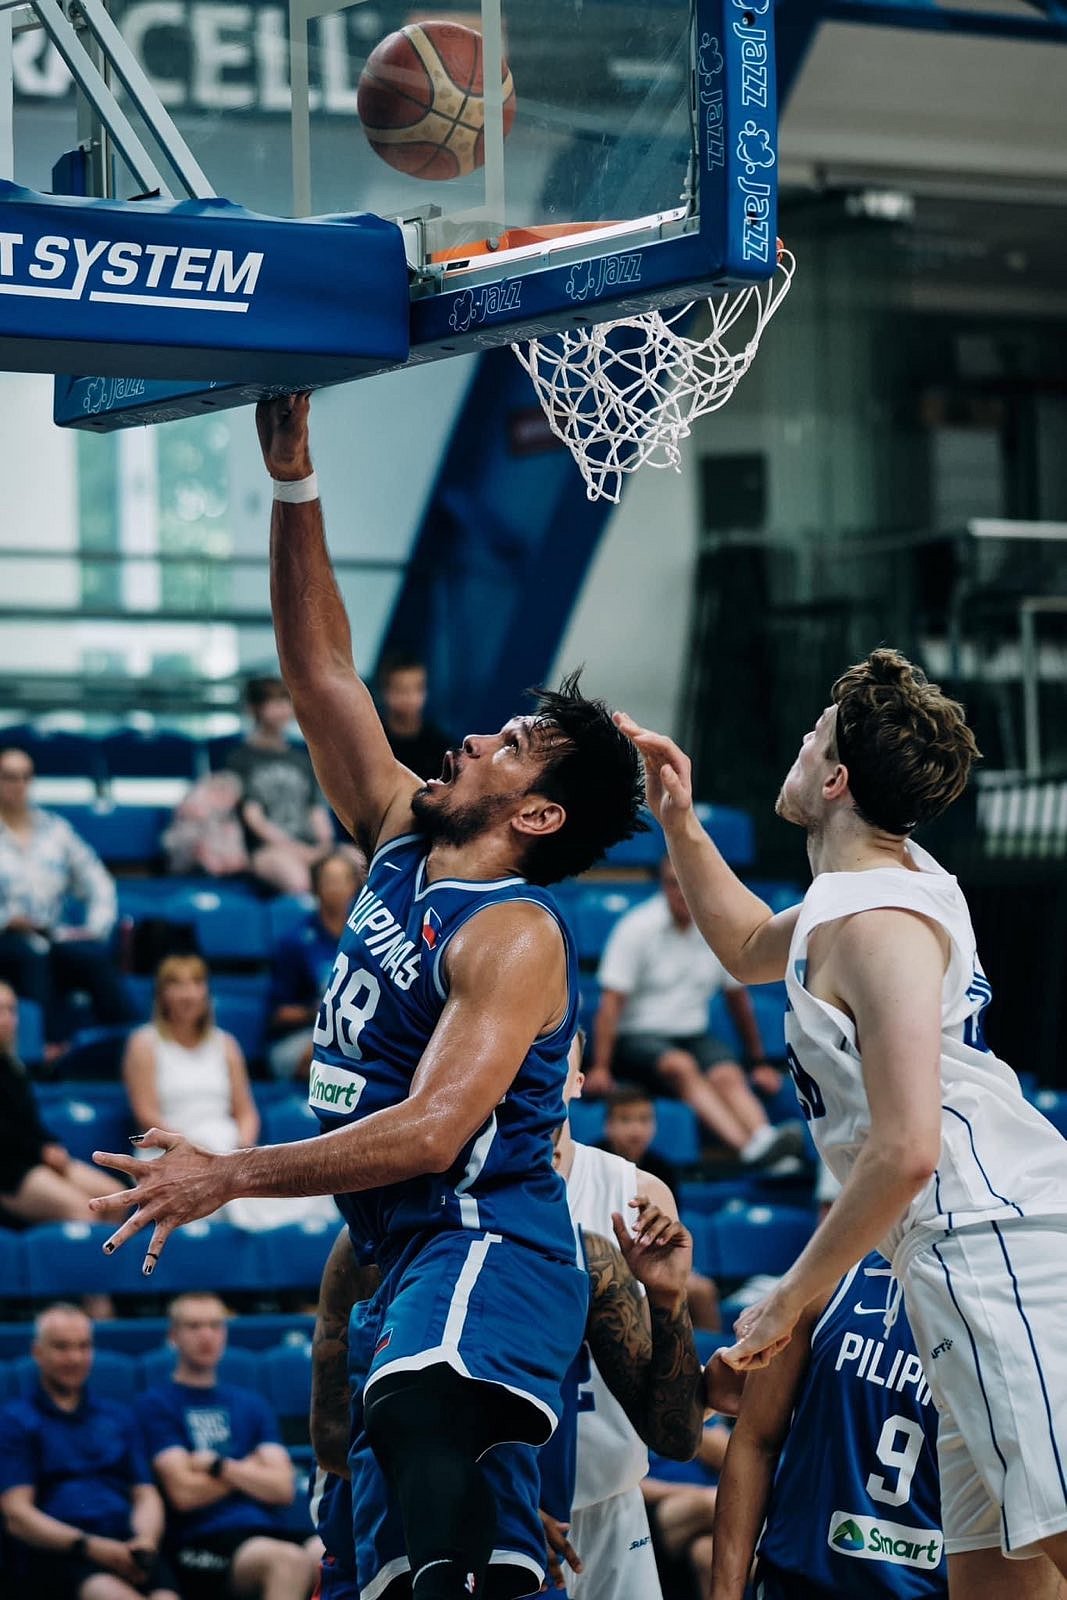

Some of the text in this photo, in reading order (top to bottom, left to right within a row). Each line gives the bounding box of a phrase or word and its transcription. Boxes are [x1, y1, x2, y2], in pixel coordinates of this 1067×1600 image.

[28, 235, 264, 300] SYSTEM
[313, 952, 381, 1060] 38
[866, 1414, 925, 1507] 9
[868, 1528, 938, 1562] Smart
